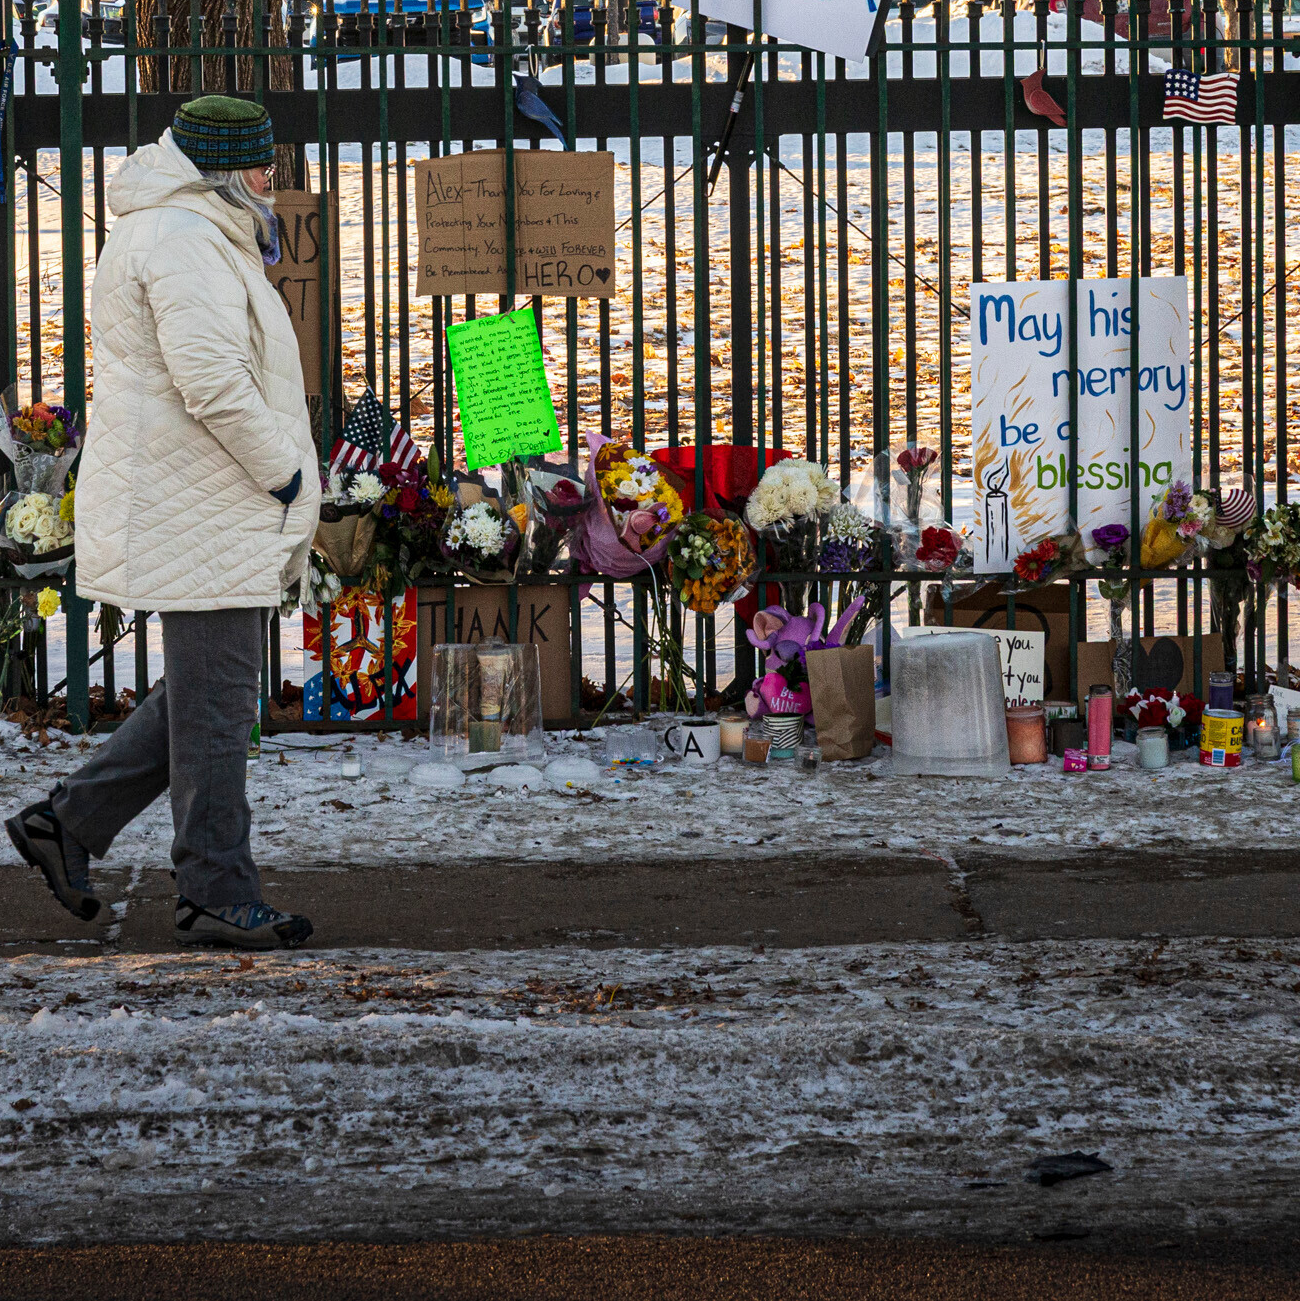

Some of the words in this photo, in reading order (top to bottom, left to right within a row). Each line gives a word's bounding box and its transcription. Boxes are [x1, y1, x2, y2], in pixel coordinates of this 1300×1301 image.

[0, 89, 8, 110] FORCE
[539, 180, 555, 196] For
[559, 183, 592, 204] Loving
[426, 212, 473, 231] Protecting
[476, 214, 495, 228] Your
[553, 214, 578, 225] This
[535, 244, 557, 255] will
[561, 241, 606, 255] FOREVER
[425, 266, 436, 278] Be
[441, 266, 492, 278] Remembered
[524, 261, 594, 287] HERO
[979, 293, 1062, 358] May
[1089, 289, 1140, 338] his
[1052, 364, 1186, 411] memory
[467, 428, 487, 444] Rest
[493, 425, 508, 435] In
[515, 416, 543, 429] Peace
[472, 442, 485, 453] my
[513, 426, 539, 439] friend
[1000, 414, 1041, 448] be
[1057, 420, 1079, 441] a
[477, 446, 511, 464] ALEX
[1037, 447, 1172, 500] blessing
[418, 601, 552, 647] THANK
[770, 697, 802, 713] MINE
[780, 686, 794, 700] BE
[684, 731, 704, 758] A
